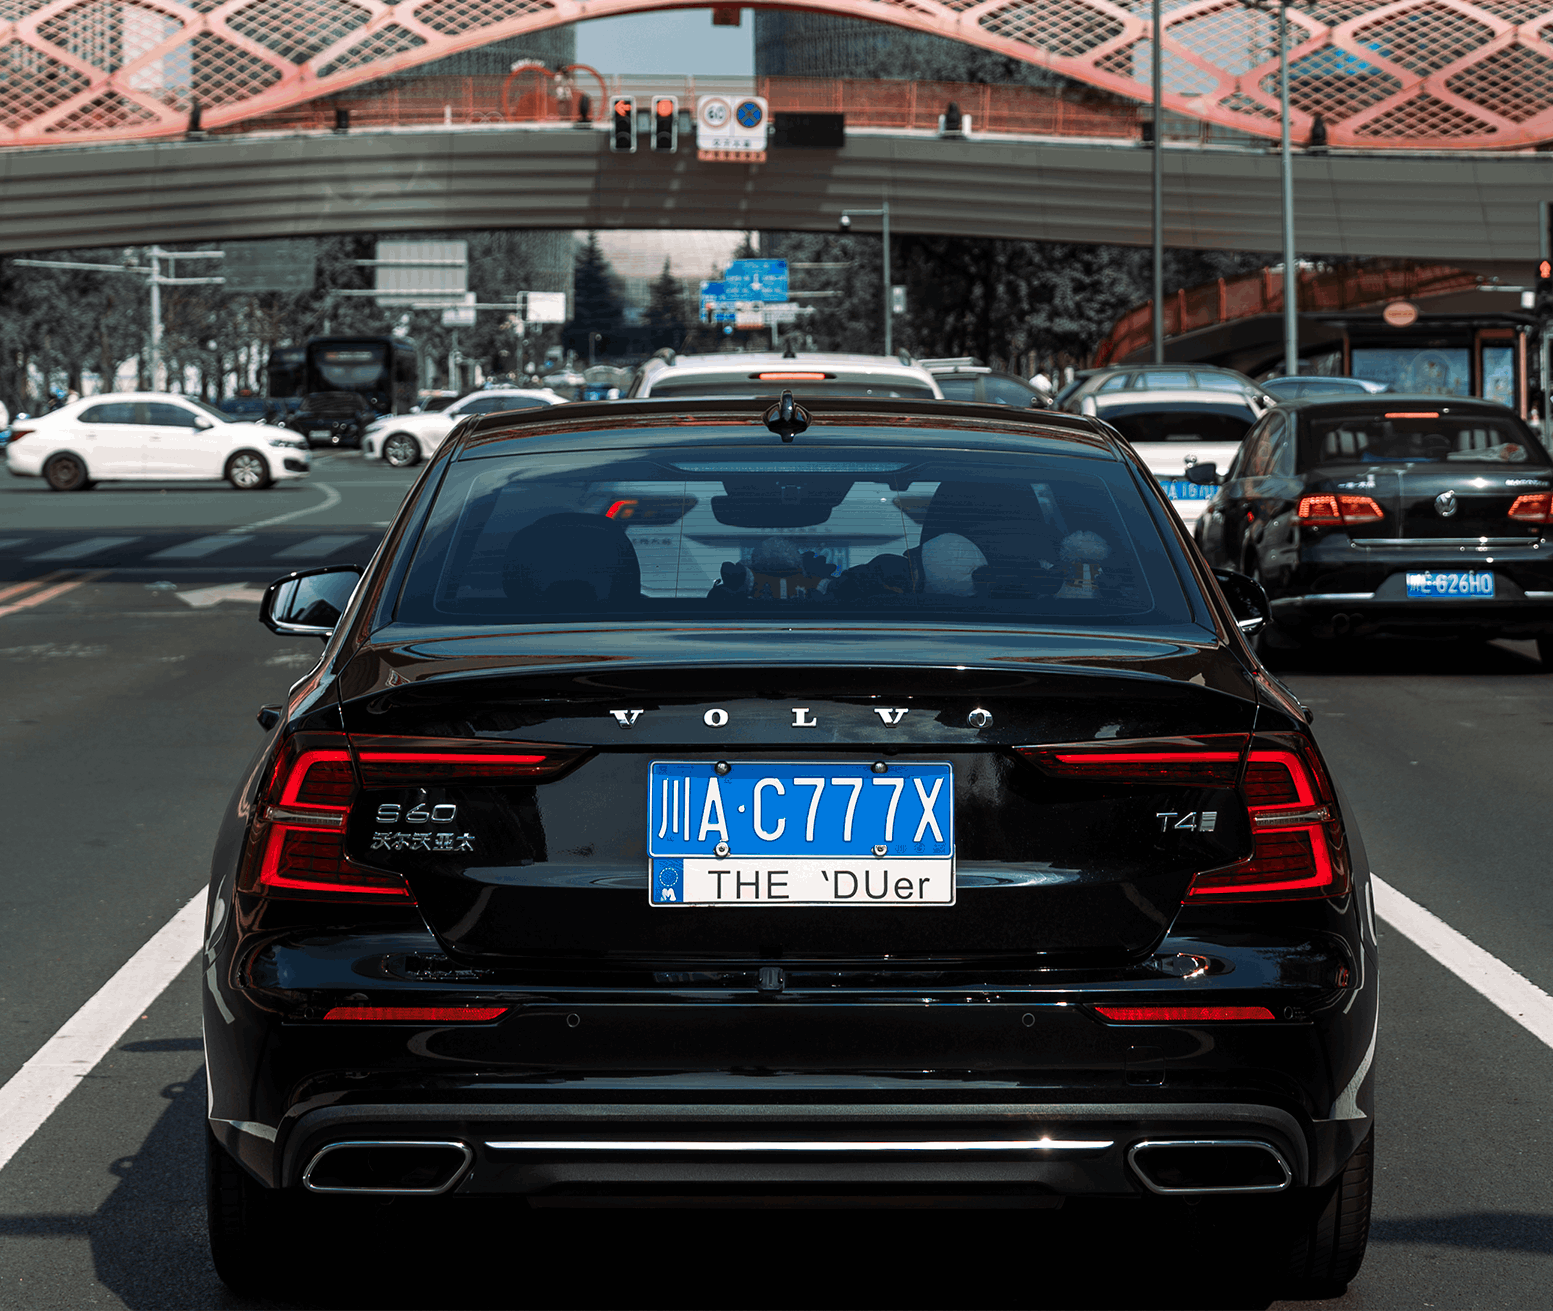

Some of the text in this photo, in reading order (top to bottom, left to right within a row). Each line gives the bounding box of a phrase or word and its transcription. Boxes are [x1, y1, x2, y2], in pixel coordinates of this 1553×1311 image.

[609, 708, 994, 729] VOLVO
[376, 802, 457, 823] S60
[370, 831, 476, 851] 沃尔沃亚太
[708, 870, 790, 899] THE
